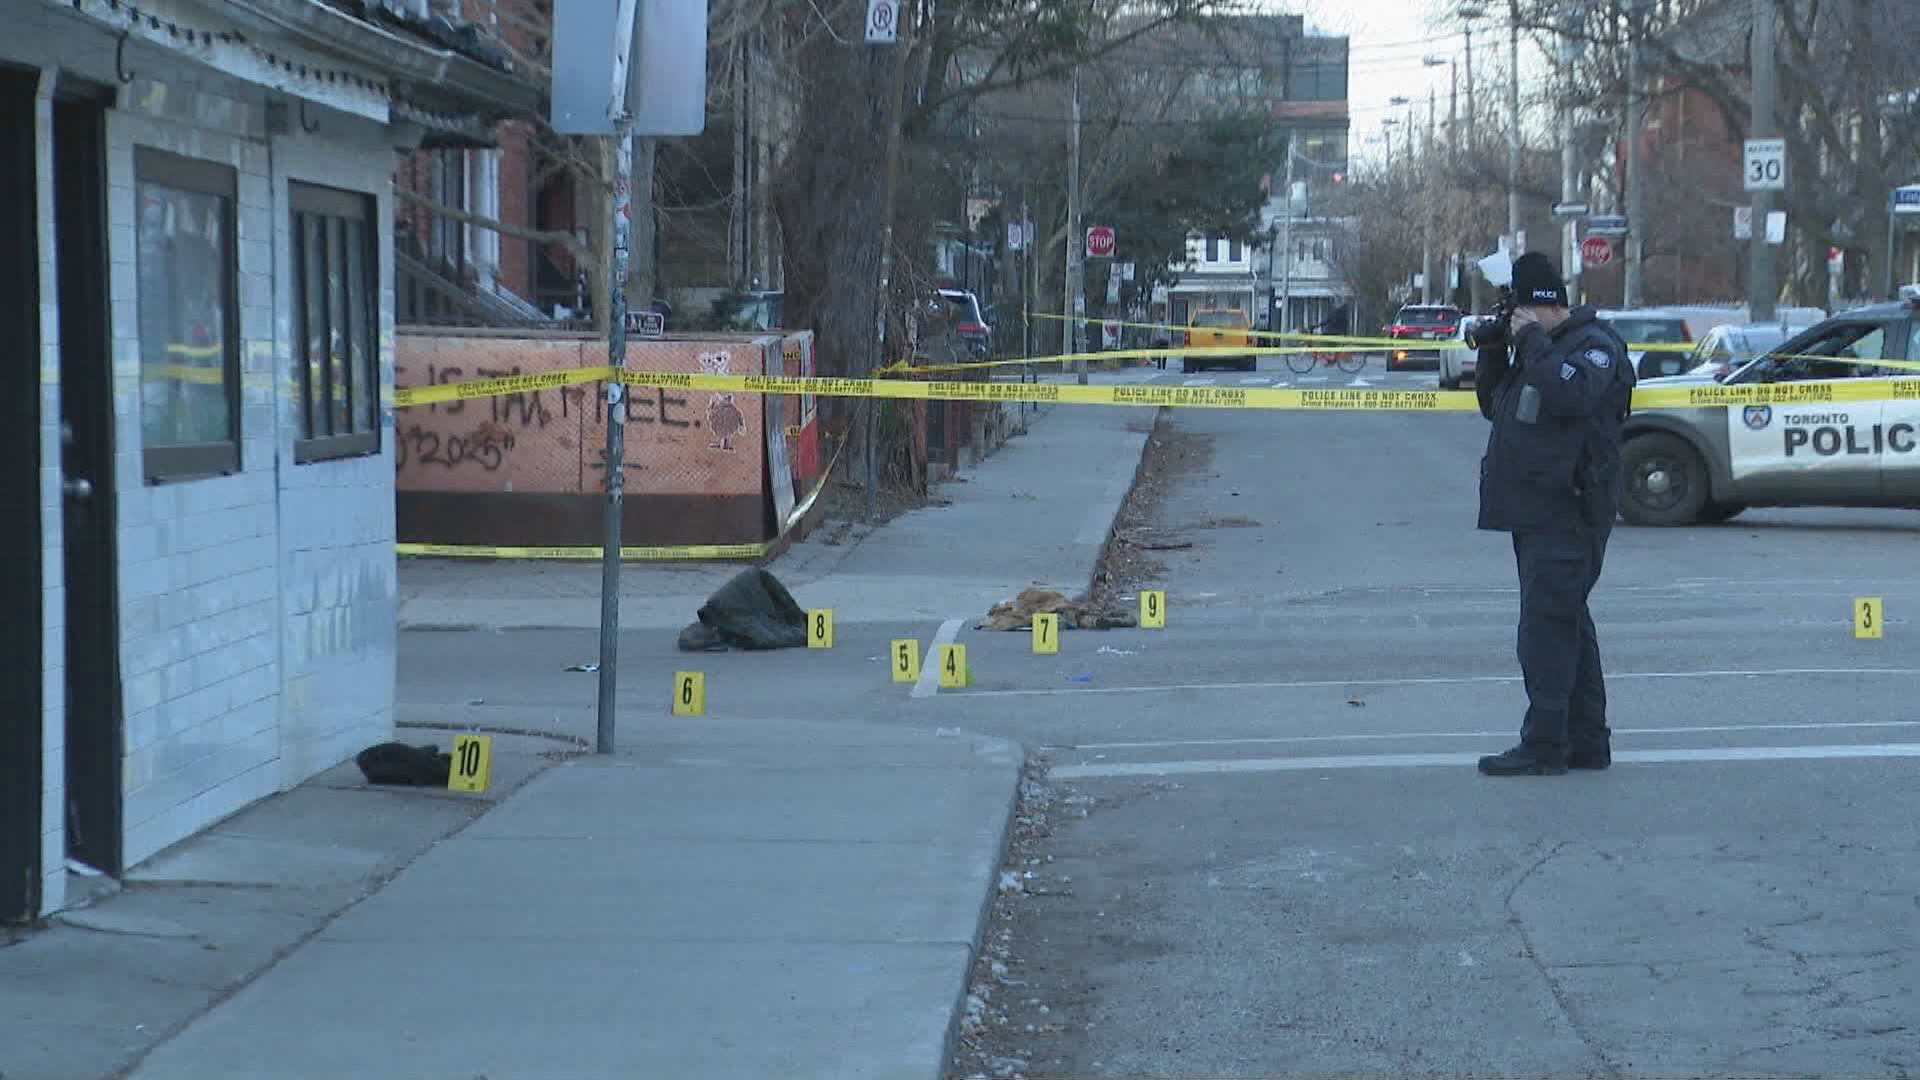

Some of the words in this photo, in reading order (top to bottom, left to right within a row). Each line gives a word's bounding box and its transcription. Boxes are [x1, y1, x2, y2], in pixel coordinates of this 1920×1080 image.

[1751, 159, 1780, 181] 30
[1088, 236, 1113, 249] STOP
[1302, 391, 1335, 400] POLICE
[1340, 391, 1360, 400] LINE
[1366, 391, 1378, 400] DO
[1382, 392, 1400, 400] NOT
[1690, 389, 1727, 397] POLICE
[1730, 388, 1753, 396] LINE
[1757, 387, 1770, 395] DO
[1775, 386, 1793, 395] NOT
[1799, 384, 1832, 394] CROSS
[1784, 413, 1849, 425] TORONTO
[1148, 593, 1157, 617] 9
[1863, 602, 1872, 628] 3
[816, 615, 825, 639] 8
[1040, 617, 1049, 644] 7
[900, 646, 909, 671] 5
[946, 649, 956, 676] 4
[683, 677, 692, 704] 6
[458, 739, 480, 777] 10
